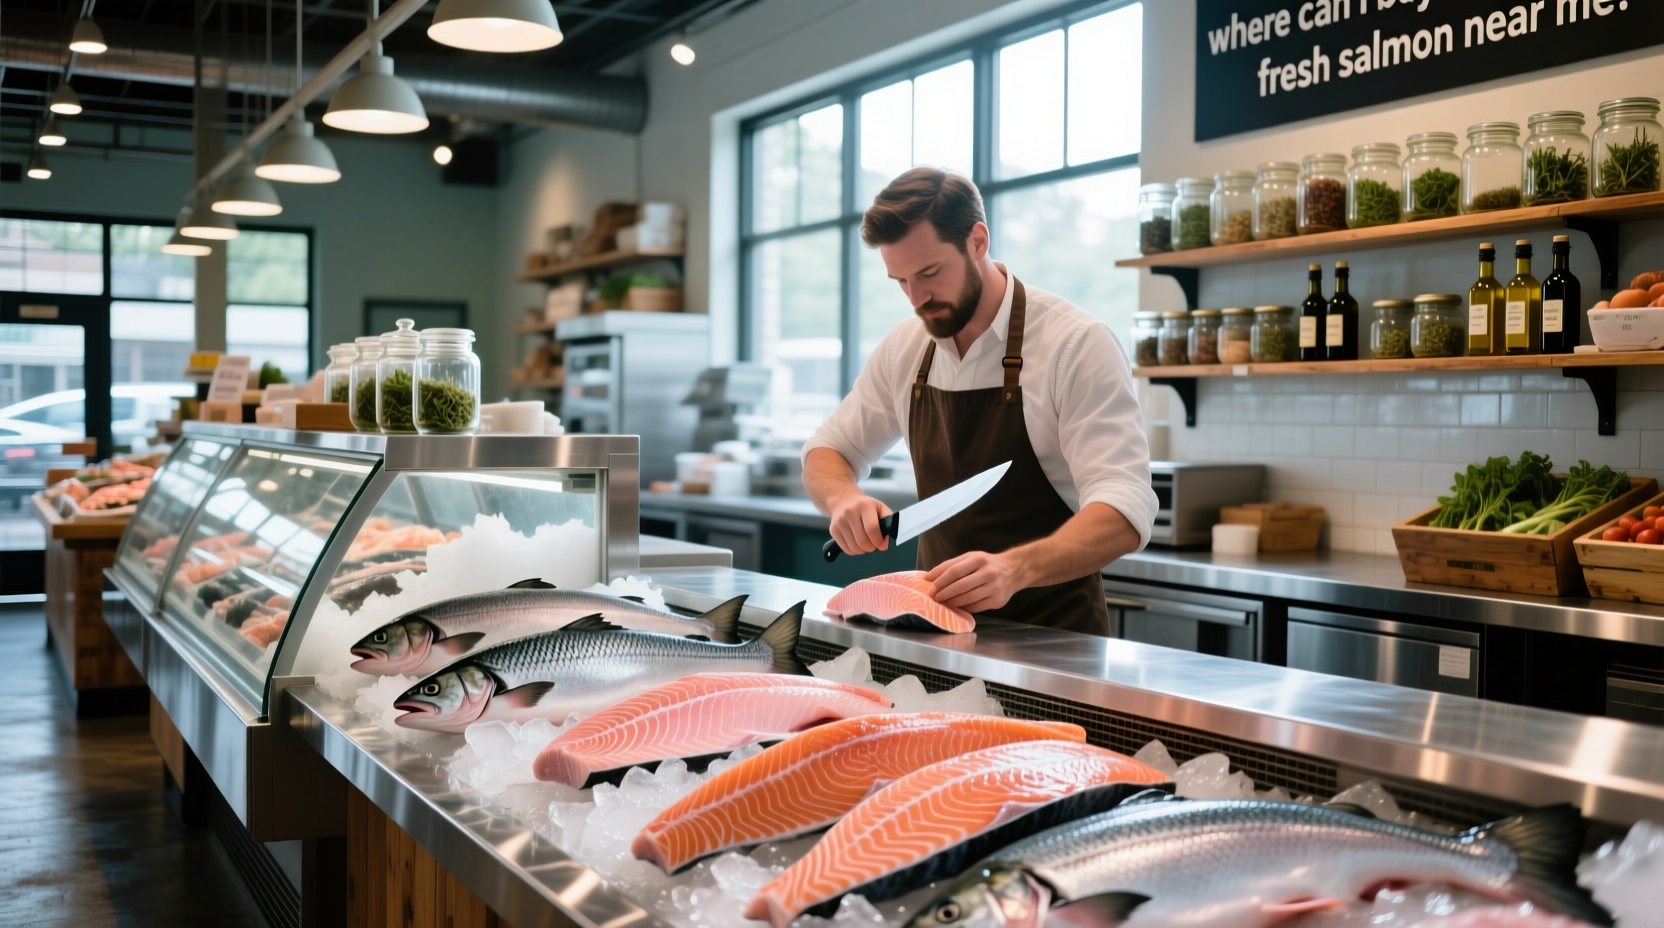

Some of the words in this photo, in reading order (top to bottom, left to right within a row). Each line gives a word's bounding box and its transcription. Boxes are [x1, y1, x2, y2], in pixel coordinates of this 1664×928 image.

[1208, 13, 1291, 55] where
[1298, 0, 1350, 31] can
[1257, 45, 1331, 97] fresh
[1338, 24, 1453, 78] salmon
[1464, 5, 1545, 48] near
